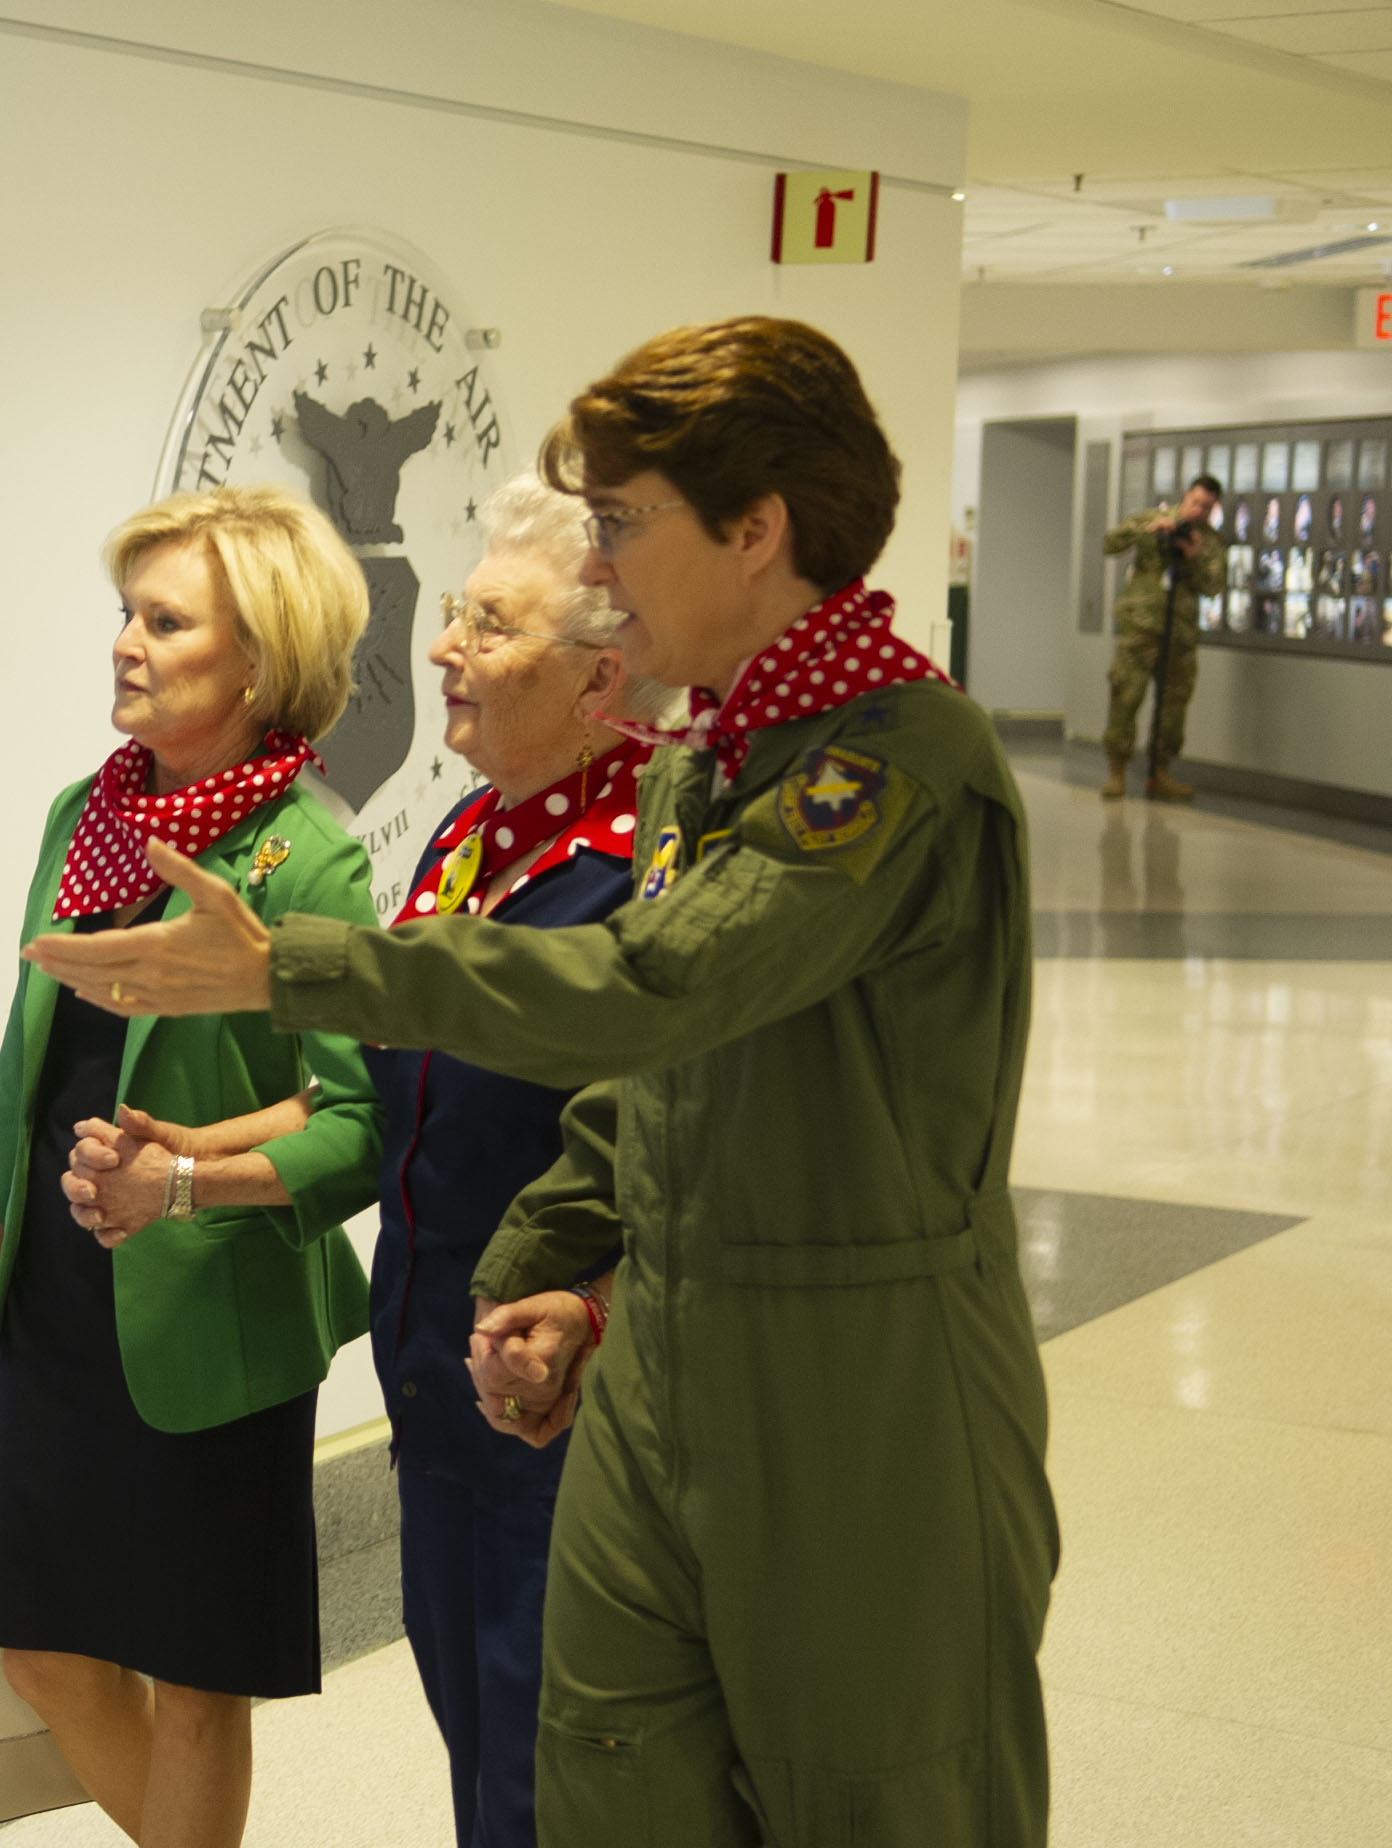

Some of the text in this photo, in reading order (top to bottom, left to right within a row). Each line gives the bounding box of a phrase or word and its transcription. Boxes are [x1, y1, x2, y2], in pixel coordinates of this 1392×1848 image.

[313, 258, 362, 317] OF
[382, 263, 451, 354] THE
[455, 365, 501, 470] AIR
[375, 882, 403, 916] OF
